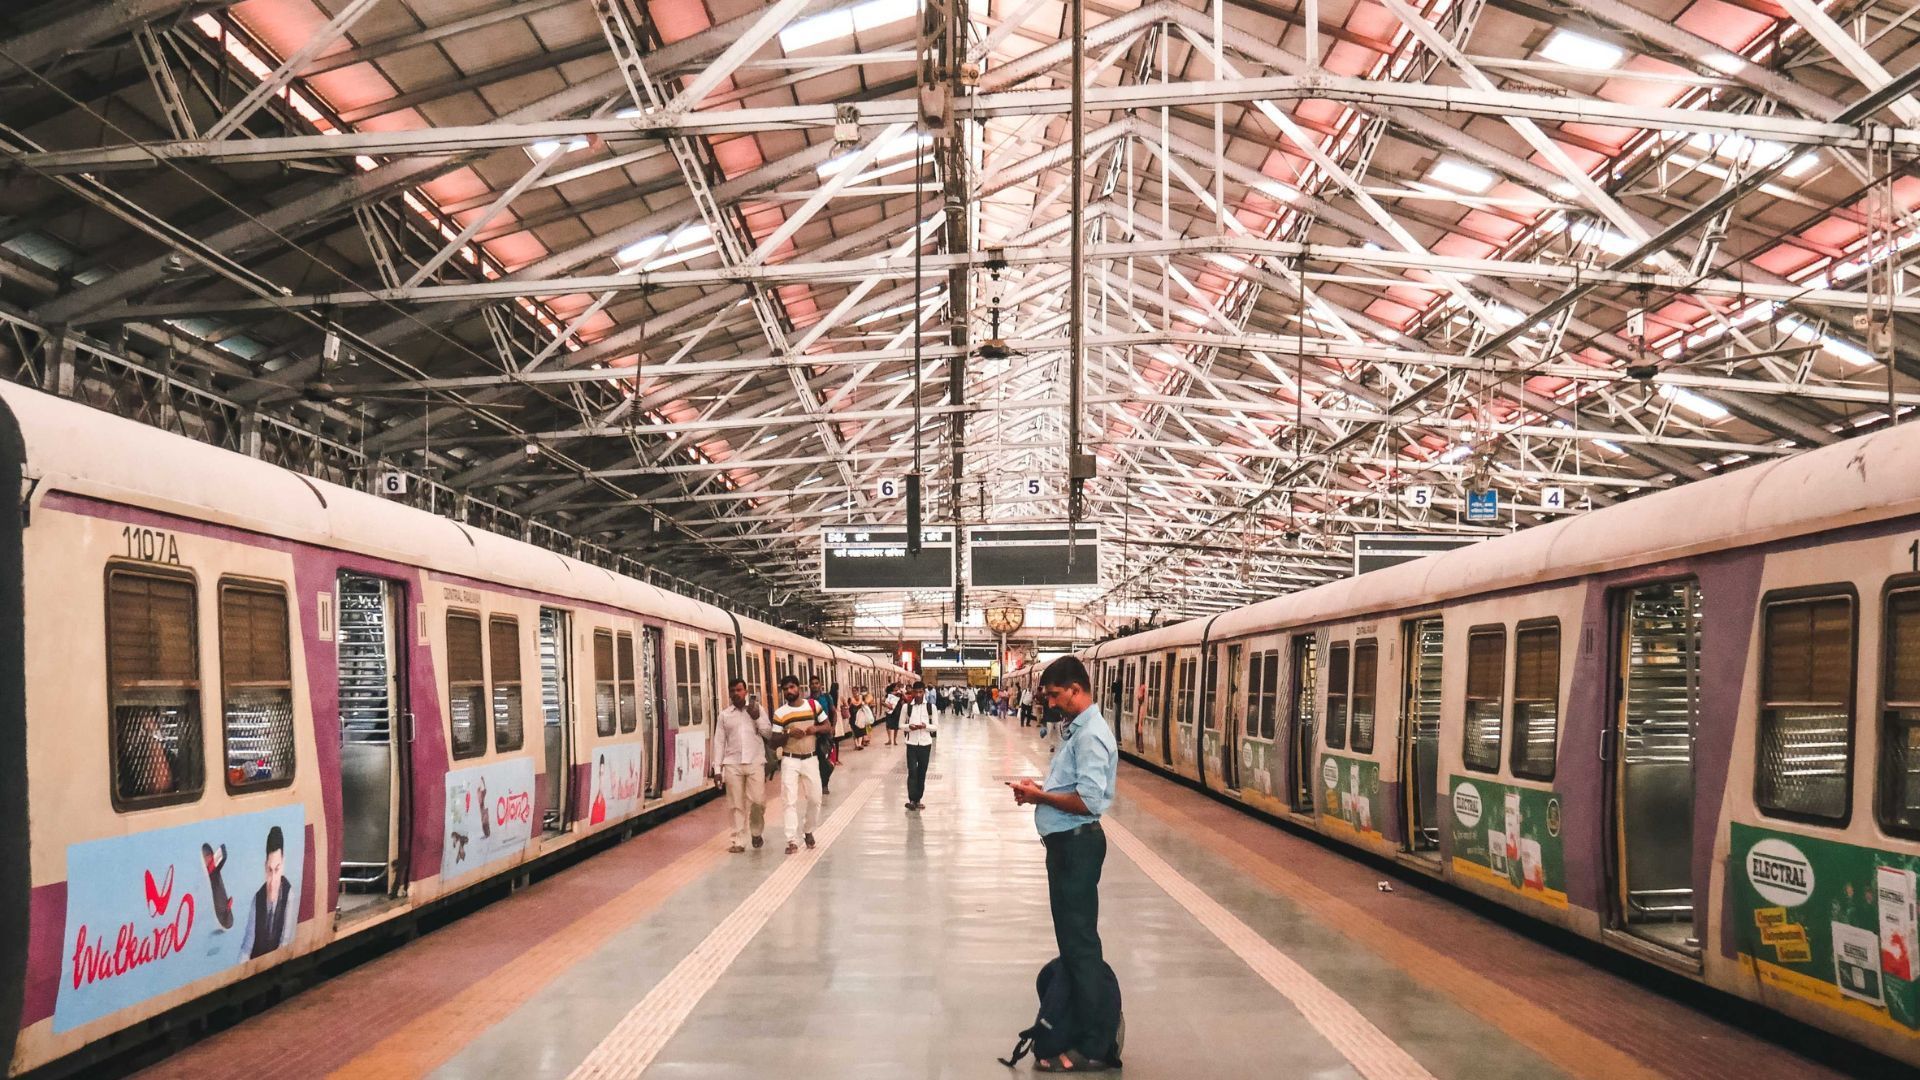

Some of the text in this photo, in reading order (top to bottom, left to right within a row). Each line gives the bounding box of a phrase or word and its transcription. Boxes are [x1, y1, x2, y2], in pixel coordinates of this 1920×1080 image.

[387, 476, 399, 491] 6
[882, 481, 894, 496] 6
[1028, 480, 1040, 494] 5
[1415, 490, 1427, 504] 5
[1548, 491, 1560, 506] 4
[122, 526, 180, 565] 1107A
[1456, 796, 1479, 813] ELECTRAL
[1752, 858, 1807, 888] ELECTRAL
